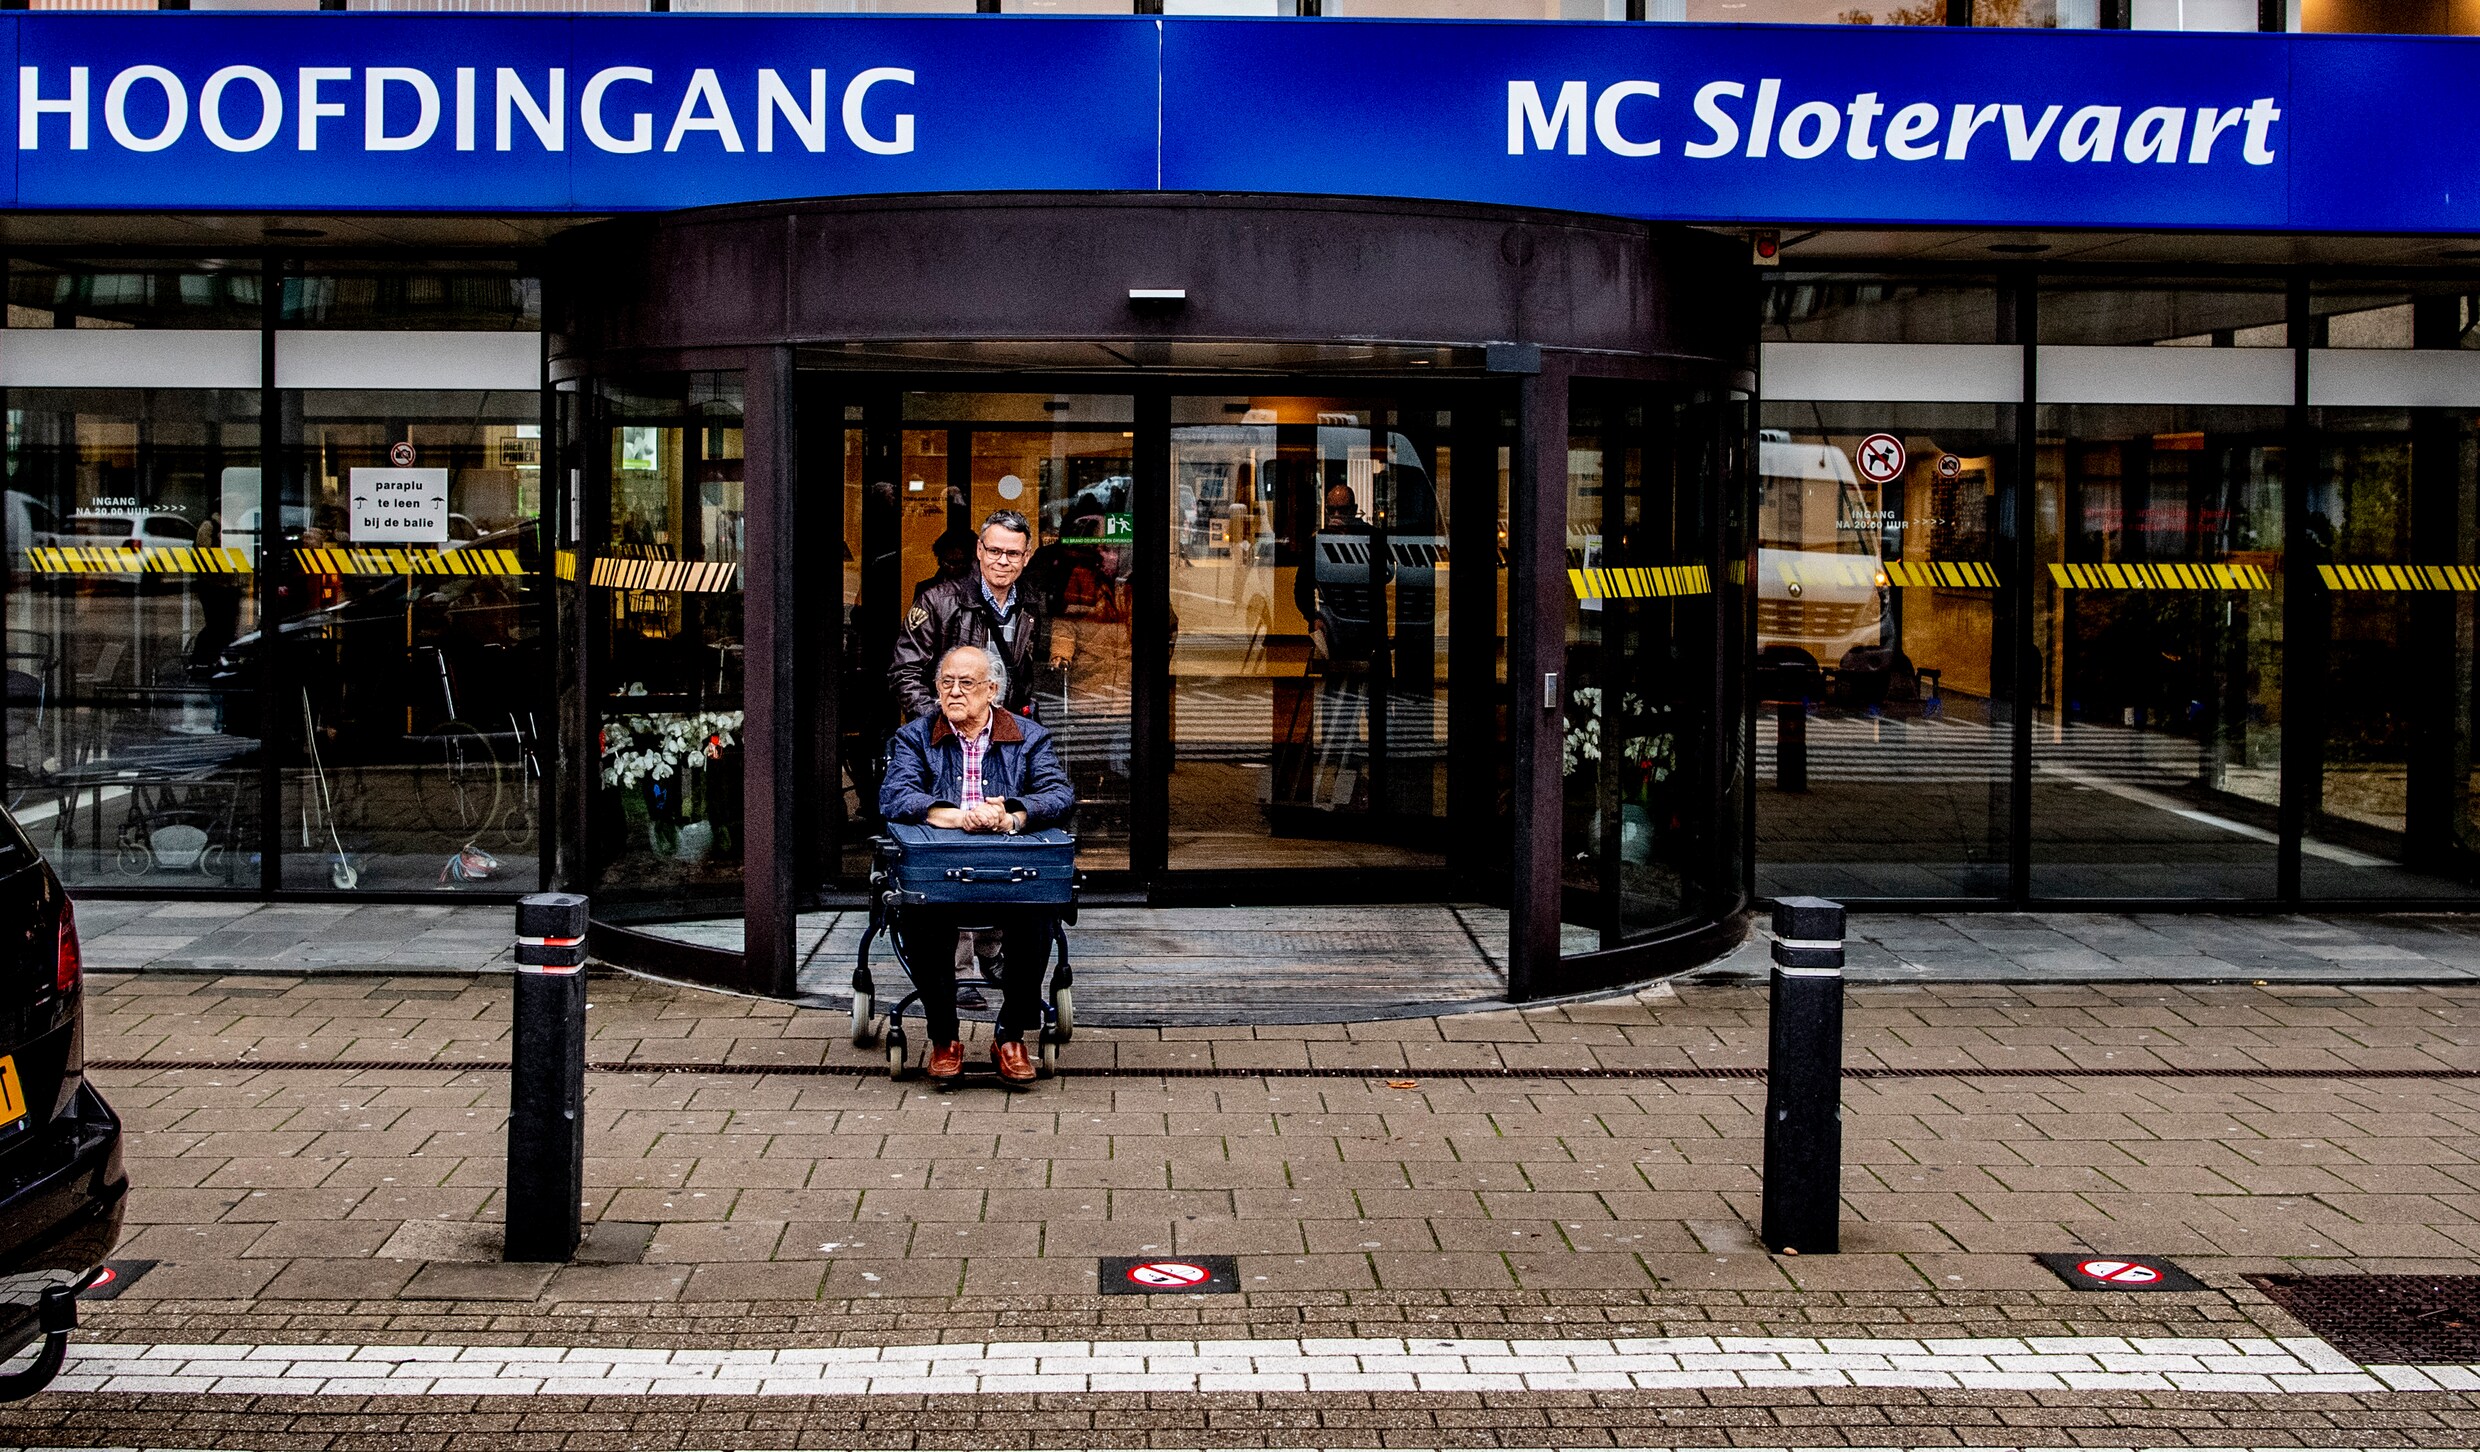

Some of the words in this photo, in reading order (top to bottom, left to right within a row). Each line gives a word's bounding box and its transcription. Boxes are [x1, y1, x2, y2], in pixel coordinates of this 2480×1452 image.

[19, 64, 915, 154] HOOFDINGANG
[1507, 80, 1661, 156] MC
[1684, 78, 2281, 166] Slotervaart
[375, 480, 423, 492] paraplu
[92, 497, 136, 506] INGANG
[377, 498, 390, 508] te
[394, 498, 420, 508] leen
[75, 507, 92, 516] NA
[126, 507, 151, 516] UUR
[1851, 510, 1896, 519] INGANG
[364, 517, 379, 529] bij
[384, 517, 399, 527] de
[403, 517, 434, 528] balie
[1835, 520, 1852, 529] NA
[1886, 520, 1909, 529] UUR
